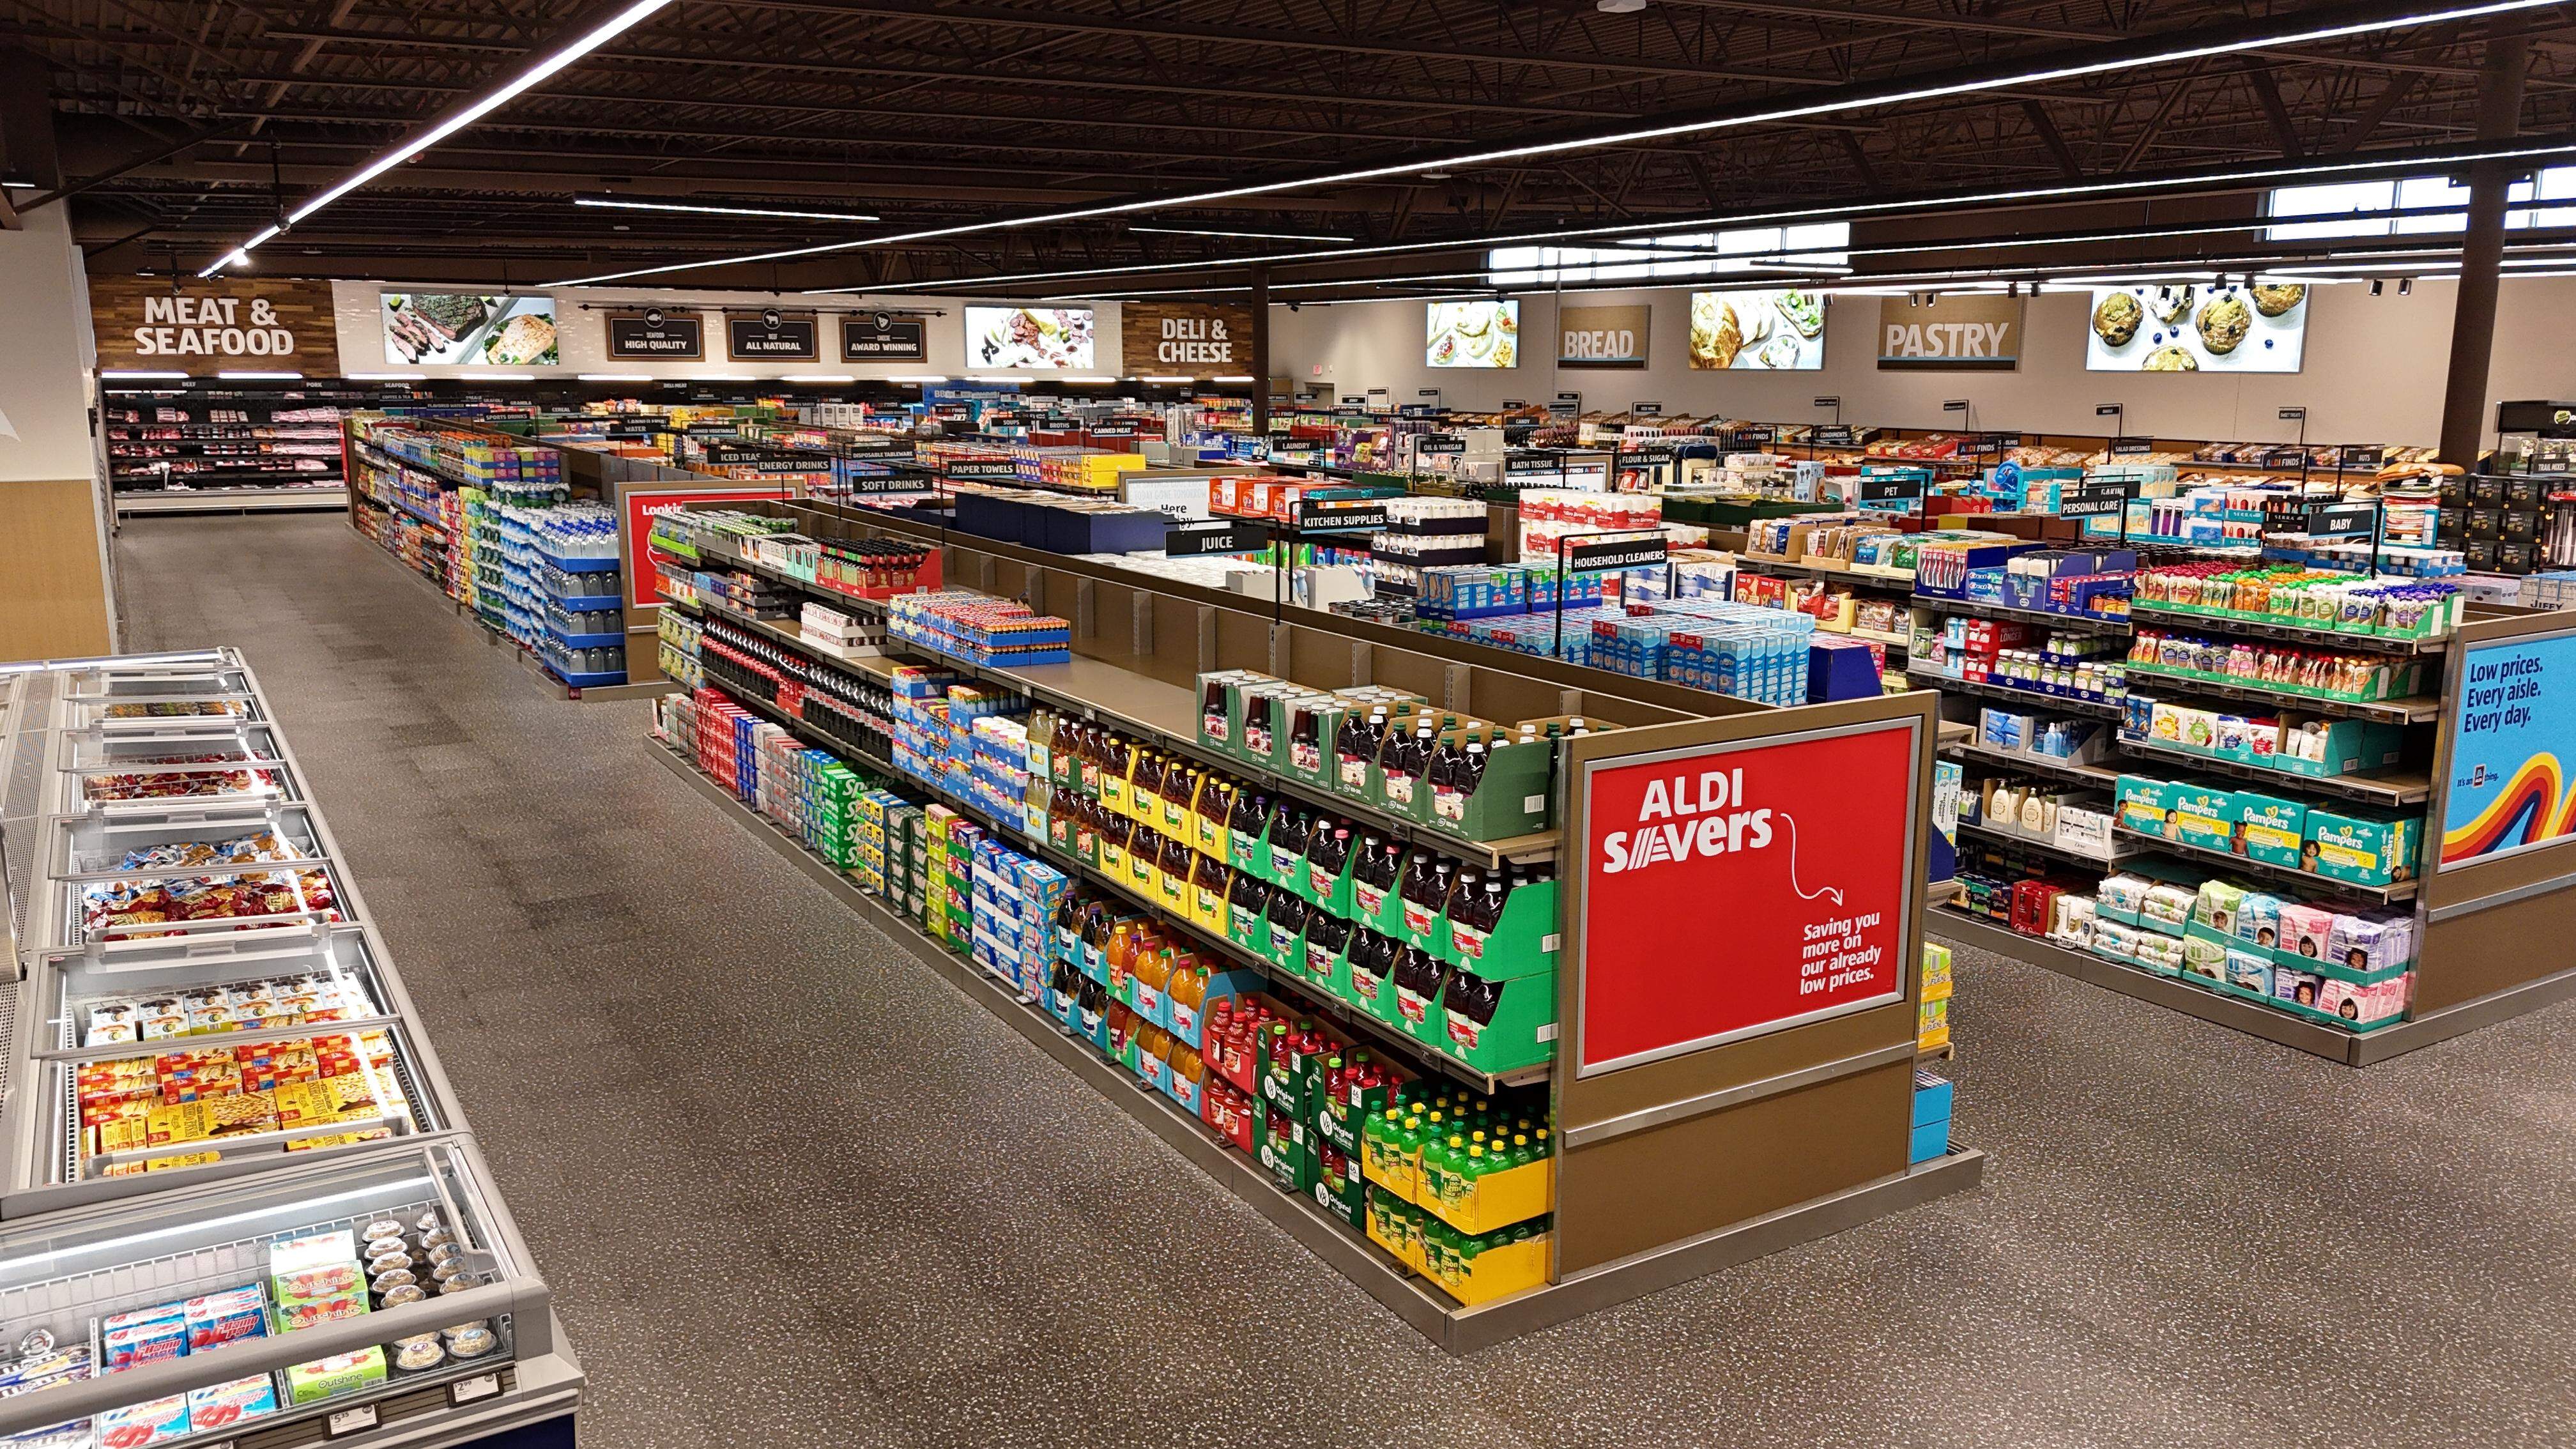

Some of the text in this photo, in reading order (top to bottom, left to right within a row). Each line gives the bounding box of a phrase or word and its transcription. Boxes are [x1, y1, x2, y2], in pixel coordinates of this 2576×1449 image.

[145, 297, 280, 326] MEAT &
[1162, 318, 1229, 341] DELI &
[135, 326, 295, 356] SEAFOOD
[625, 340, 687, 351] HIGH QUALITY
[746, 341, 801, 351] ALL NATURAL
[851, 342, 917, 353] AWARD WINNING
[1564, 330, 1634, 359] BREAD
[1885, 322, 2009, 358] PASTRY
[1158, 341, 1233, 364] CHEESE
[1439, 443, 1462, 451] VINEGAR
[1960, 444, 1995, 454] ALDI FINDS
[721, 453, 762, 462] ICED TEAS
[758, 461, 829, 471] ENERGY DRINKS
[1512, 459, 1553, 469] BATH TISSUE
[1622, 455, 1641, 463] FLOUR
[1648, 454, 1670, 463] SUGAR
[2266, 457, 2299, 467] ALDI FINDS
[2538, 463, 2550, 471] TRAIL
[952, 464, 1013, 474] PAPER TOWELS
[862, 480, 925, 491] SOFT DRINKS
[1885, 486, 1898, 496] PET
[1161, 503, 1187, 513] Here
[2062, 500, 2118, 514] PERSONAL CARE
[1304, 514, 1384, 528] KITCHEN SUPPLIES
[2330, 518, 2352, 531] BABY
[1201, 536, 1233, 552] JUICE
[1574, 549, 1665, 569] HOUSEHOLD CLEANERS
[2530, 599, 2564, 611] JIFFY
[2000, 630, 2023, 643] LONGER
[2470, 654, 2543, 684] Low prices.
[2467, 677, 2542, 709] Every aisle.
[2464, 704, 2531, 733] Every day.
[1638, 767, 1744, 823] ALDI
[2125, 788, 2158, 806] Pampers
[2177, 796, 2218, 818] Pampers
[2243, 806, 2289, 830] Pampers
[2318, 826, 2363, 850] Pampers
[2382, 833, 2394, 875] Pampers
[1803, 911, 1881, 942] Saving you
[1802, 933, 1862, 959] more on
[1801, 945, 1882, 977] our already
[1799, 967, 1874, 995] low prices.
[1266, 1078, 1275, 1098] V8
[1275, 1085, 1295, 1105] Original
[1321, 1114, 1331, 1133] V8
[1332, 1121, 1354, 1142] Original
[1262, 1148, 1273, 1168] V8
[1274, 1155, 1295, 1174] Original
[1318, 1187, 1327, 1205] V8
[1329, 1193, 1351, 1215] Original
[287, 1272, 358, 1293] Outshine
[289, 1305, 362, 1327] Outshine
[318, 1374, 363, 1389] Outshine
